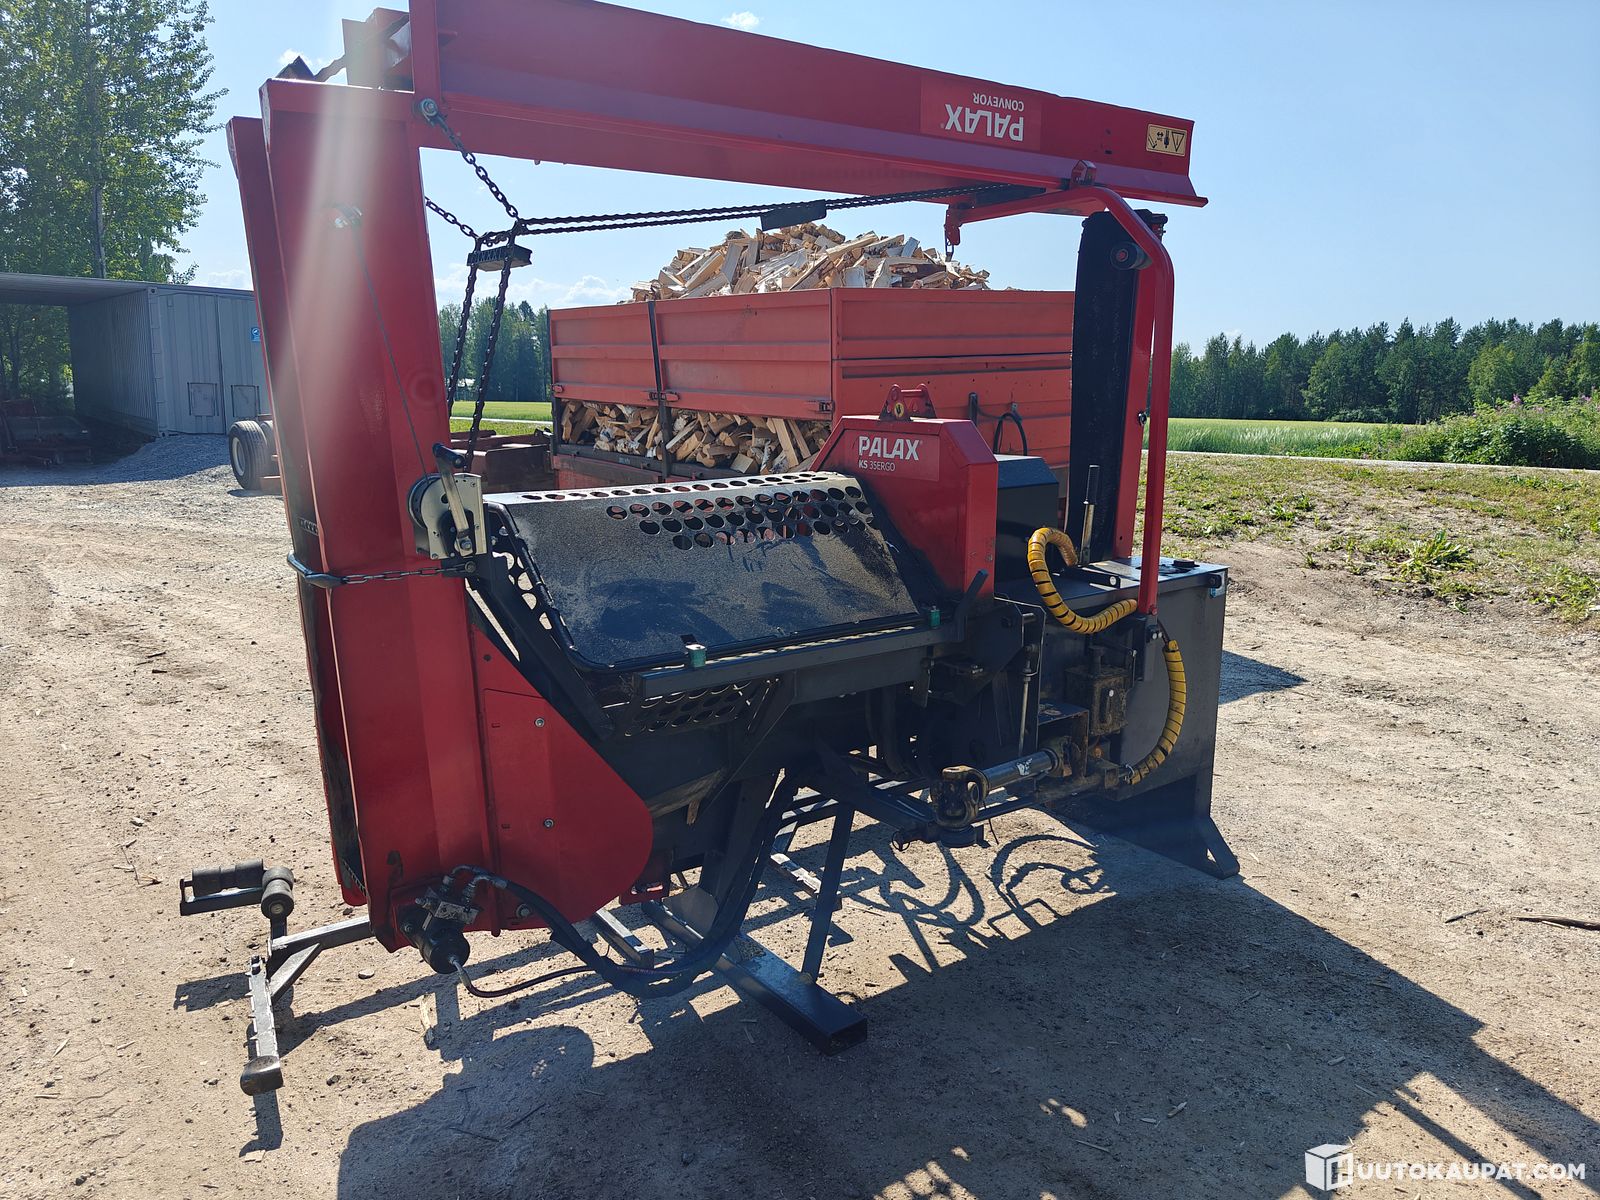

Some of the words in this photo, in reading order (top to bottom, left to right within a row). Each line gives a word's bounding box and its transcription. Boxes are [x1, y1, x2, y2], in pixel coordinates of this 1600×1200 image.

[972, 92, 1024, 112] CONVEYOR
[945, 103, 1024, 141] PALAX
[858, 435, 919, 460] PALAX
[858, 459, 868, 469] KS
